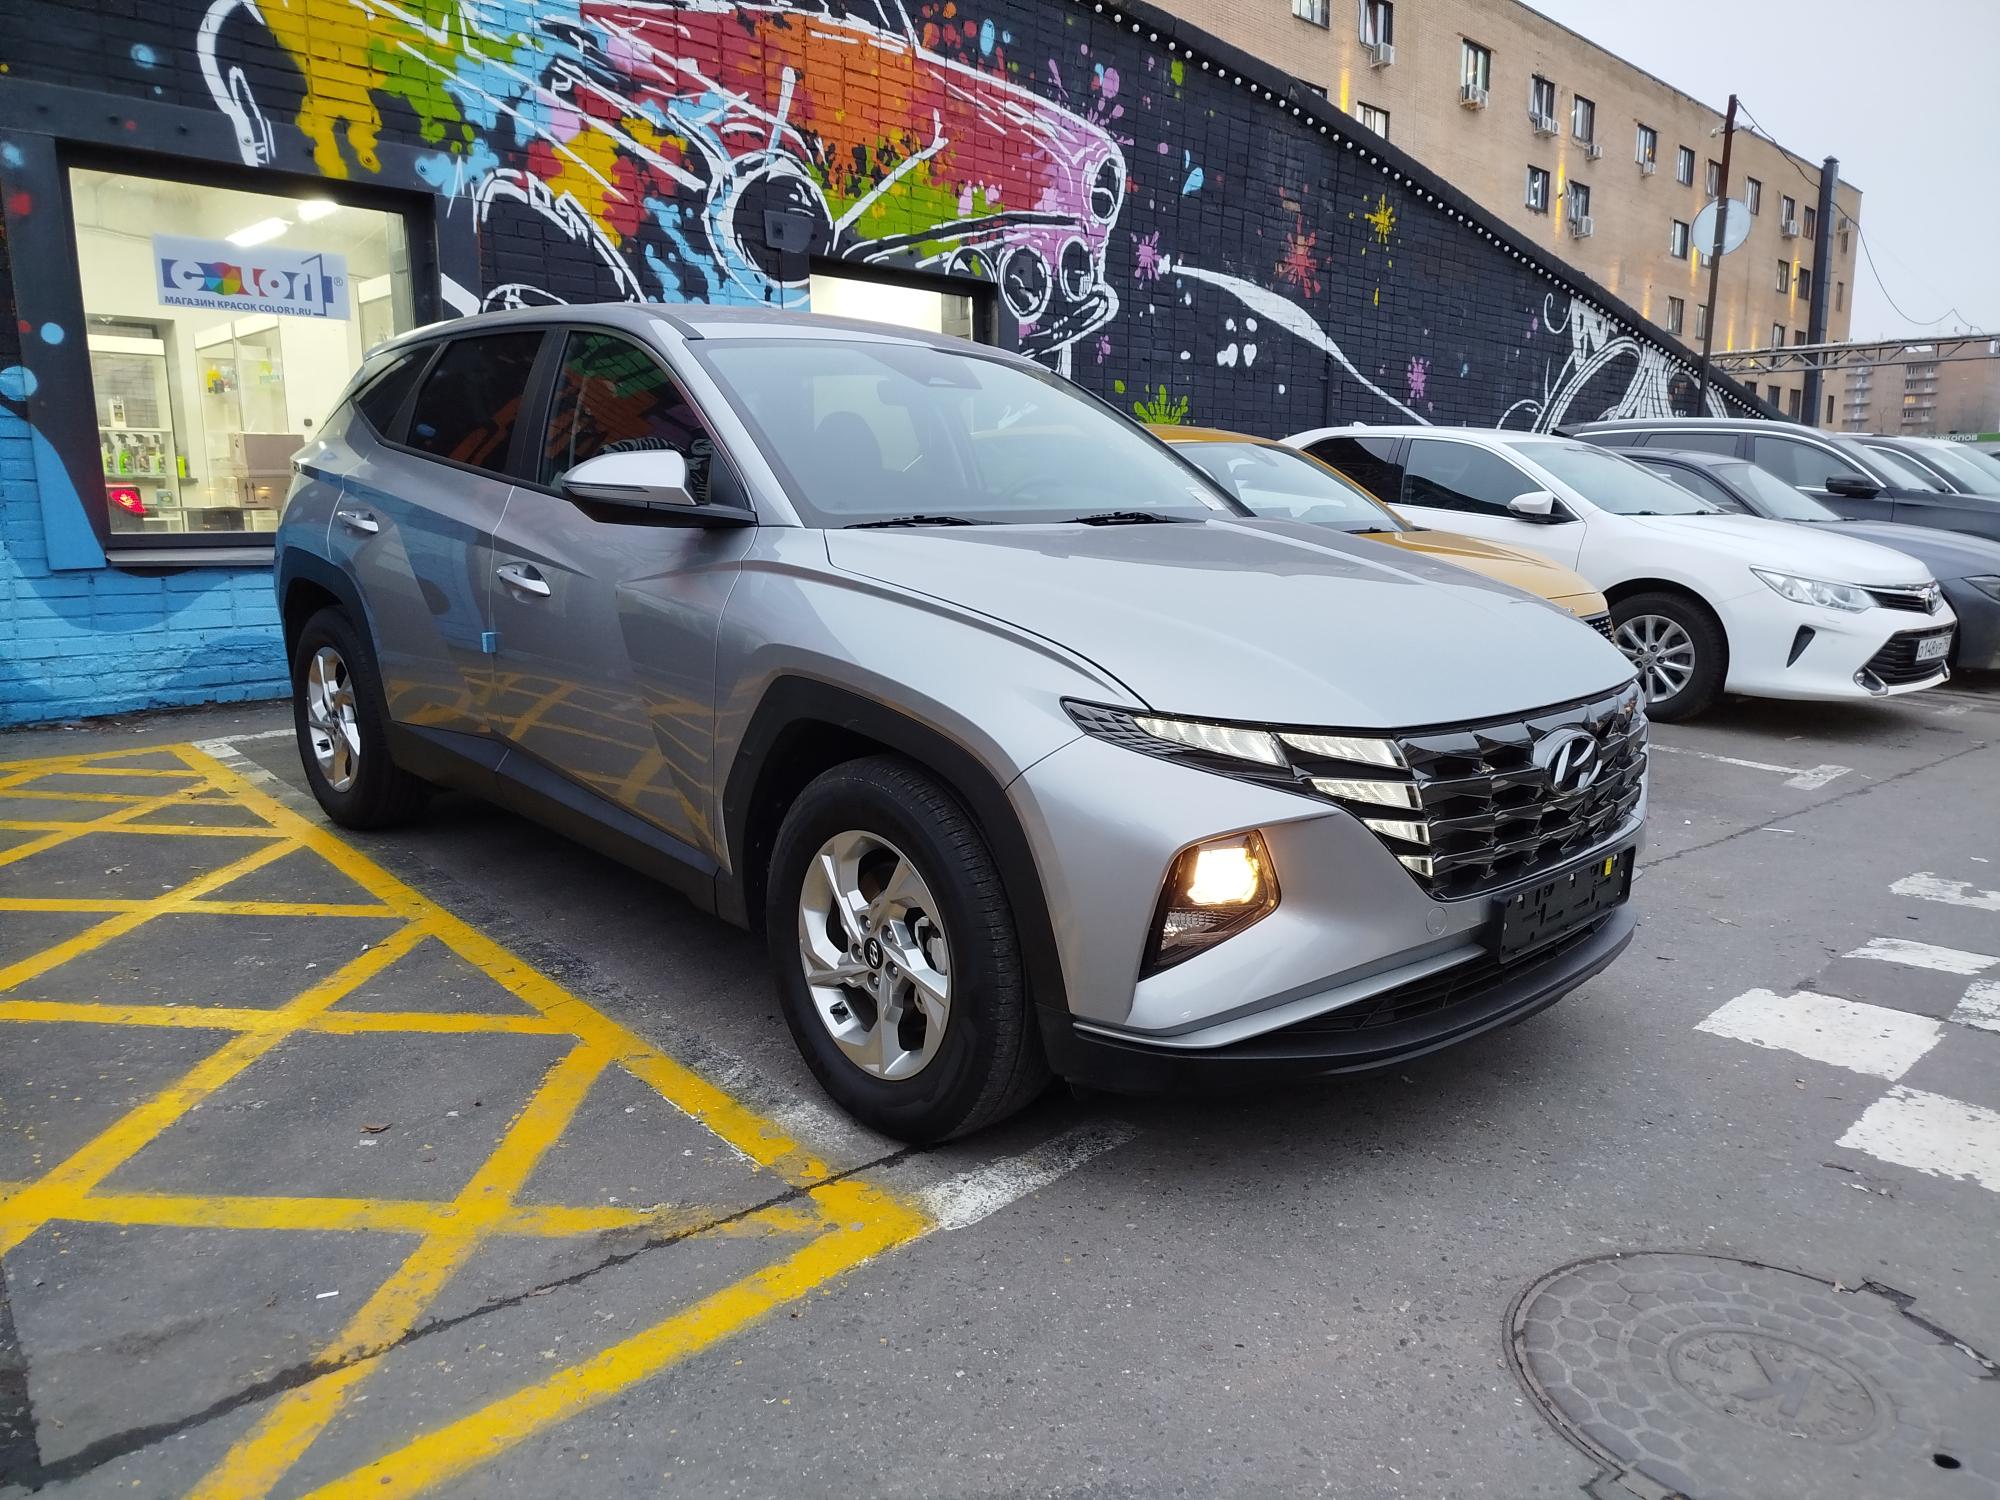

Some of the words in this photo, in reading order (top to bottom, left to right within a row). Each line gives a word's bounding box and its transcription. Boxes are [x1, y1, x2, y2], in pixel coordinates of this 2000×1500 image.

[164, 295, 215, 308] МАГАЗИН
[217, 299, 257, 312] КРАСОК
[258, 304, 312, 316] COLOR1.RU
